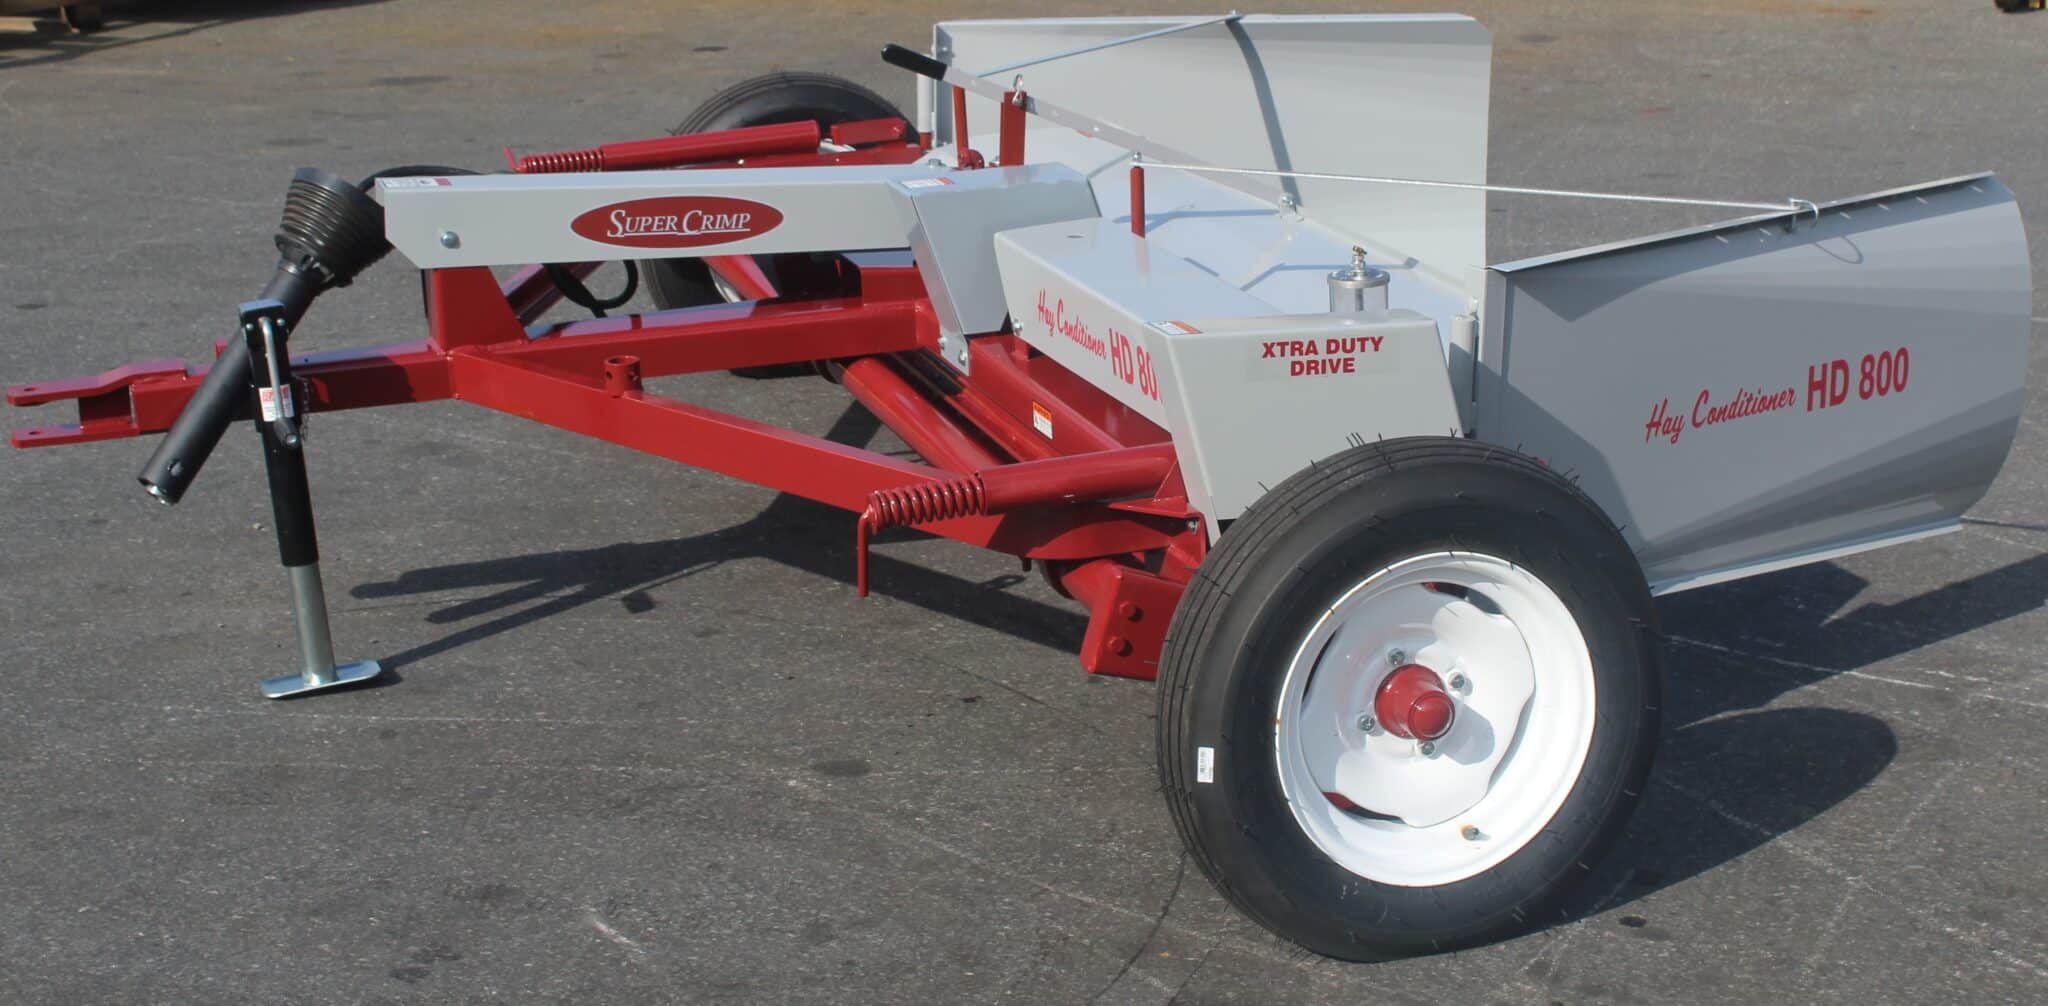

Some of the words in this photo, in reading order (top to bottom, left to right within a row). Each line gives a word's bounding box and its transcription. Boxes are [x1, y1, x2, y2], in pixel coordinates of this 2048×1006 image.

[607, 209, 678, 237] SUPER
[682, 209, 751, 235] CRIMP
[1037, 288, 1055, 337] Hay
[1057, 298, 1107, 360] Conditioner
[1108, 327, 1134, 384] HD
[1136, 344, 1163, 404] 80
[1262, 340, 1319, 359] XTRA
[1326, 335, 1384, 355] DUTY
[1290, 357, 1355, 376] DRIVE
[1645, 398, 1685, 444] Hay
[1691, 388, 1797, 428] Conditioner
[1806, 358, 1850, 412] HD
[1858, 346, 1909, 400] 800
